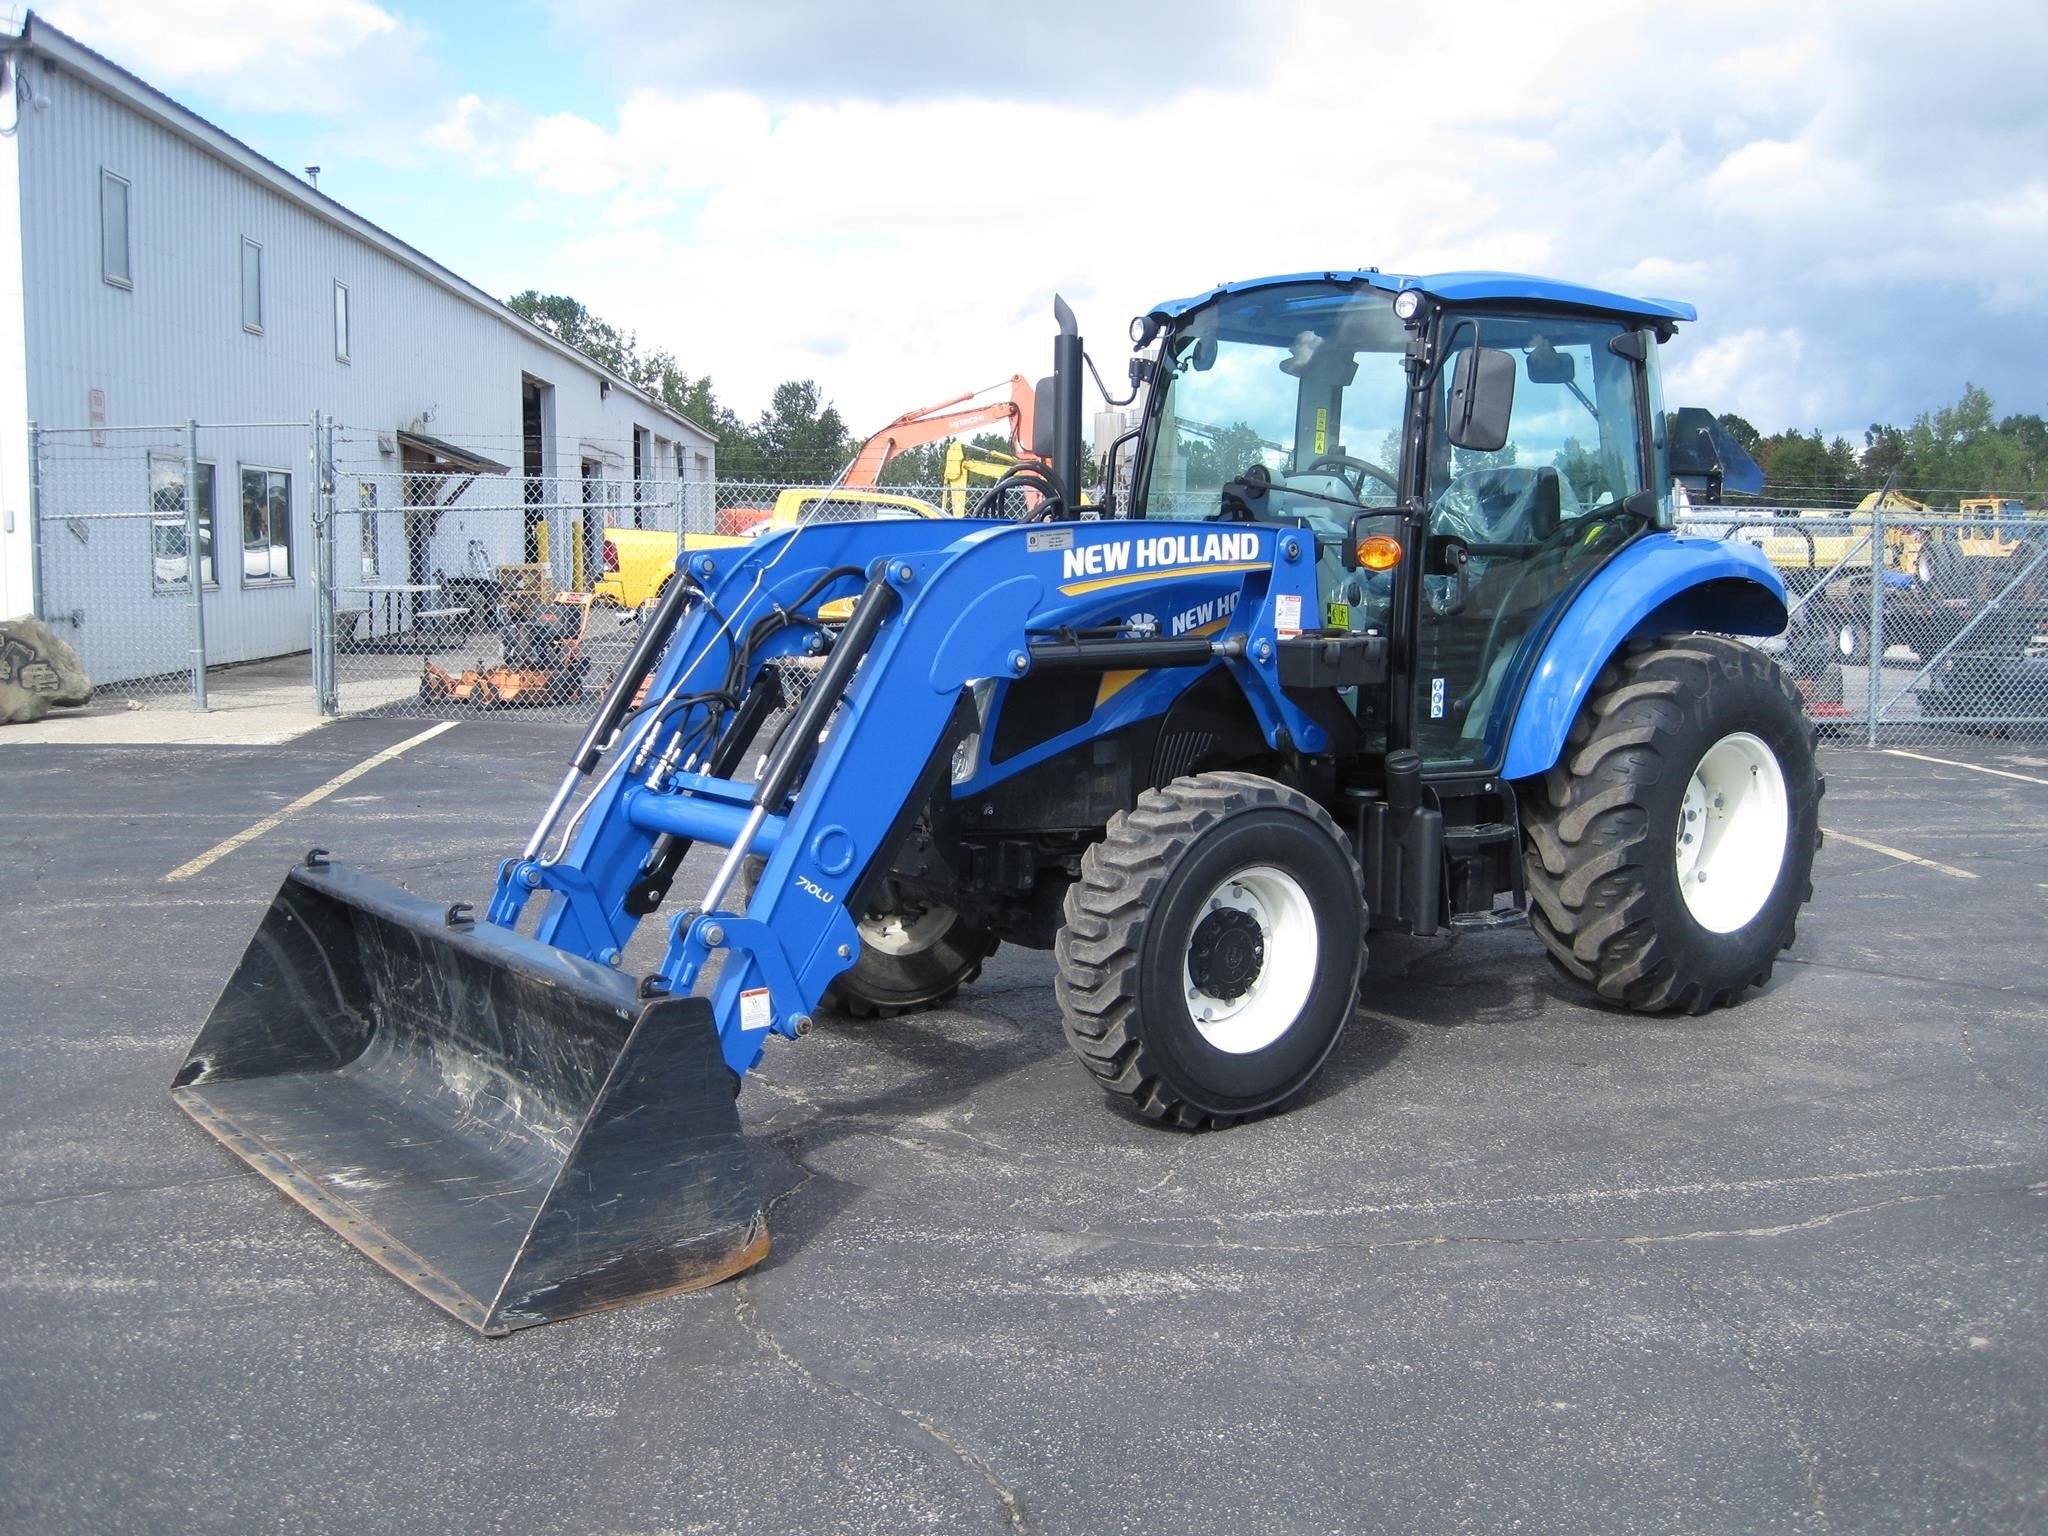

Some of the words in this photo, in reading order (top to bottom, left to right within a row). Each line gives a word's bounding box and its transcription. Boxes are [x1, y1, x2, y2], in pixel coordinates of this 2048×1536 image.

[950, 415, 984, 429] HITACHI
[1063, 541, 1131, 579] NEW
[1137, 533, 1259, 568] HOLLAND
[1172, 601, 1213, 637] NEW
[795, 875, 834, 903] 710LU
